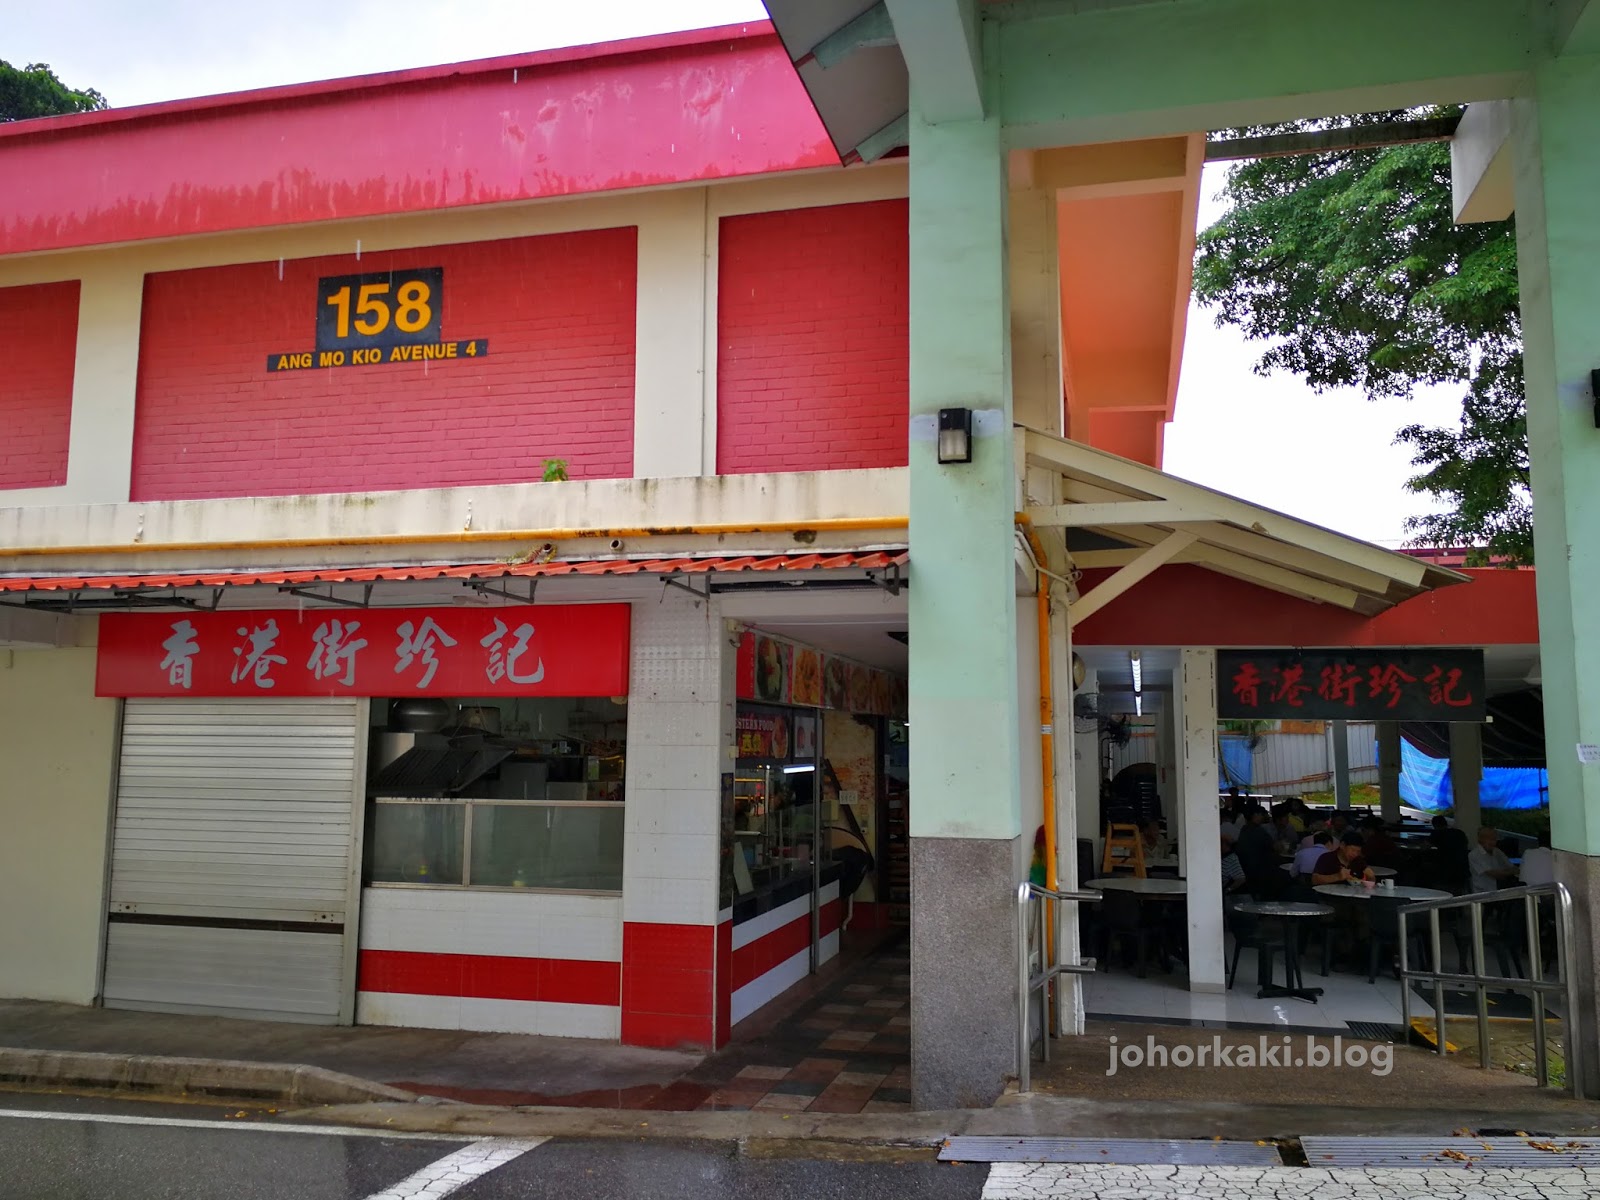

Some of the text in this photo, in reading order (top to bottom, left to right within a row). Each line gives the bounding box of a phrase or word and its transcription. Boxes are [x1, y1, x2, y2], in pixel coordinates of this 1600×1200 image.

[327, 280, 431, 338] 158
[277, 341, 477, 370] ANG MO KIO AVENUE 4
[160, 616, 545, 689] 香港街珍記
[1232, 662, 1472, 708] 香港街珍記
